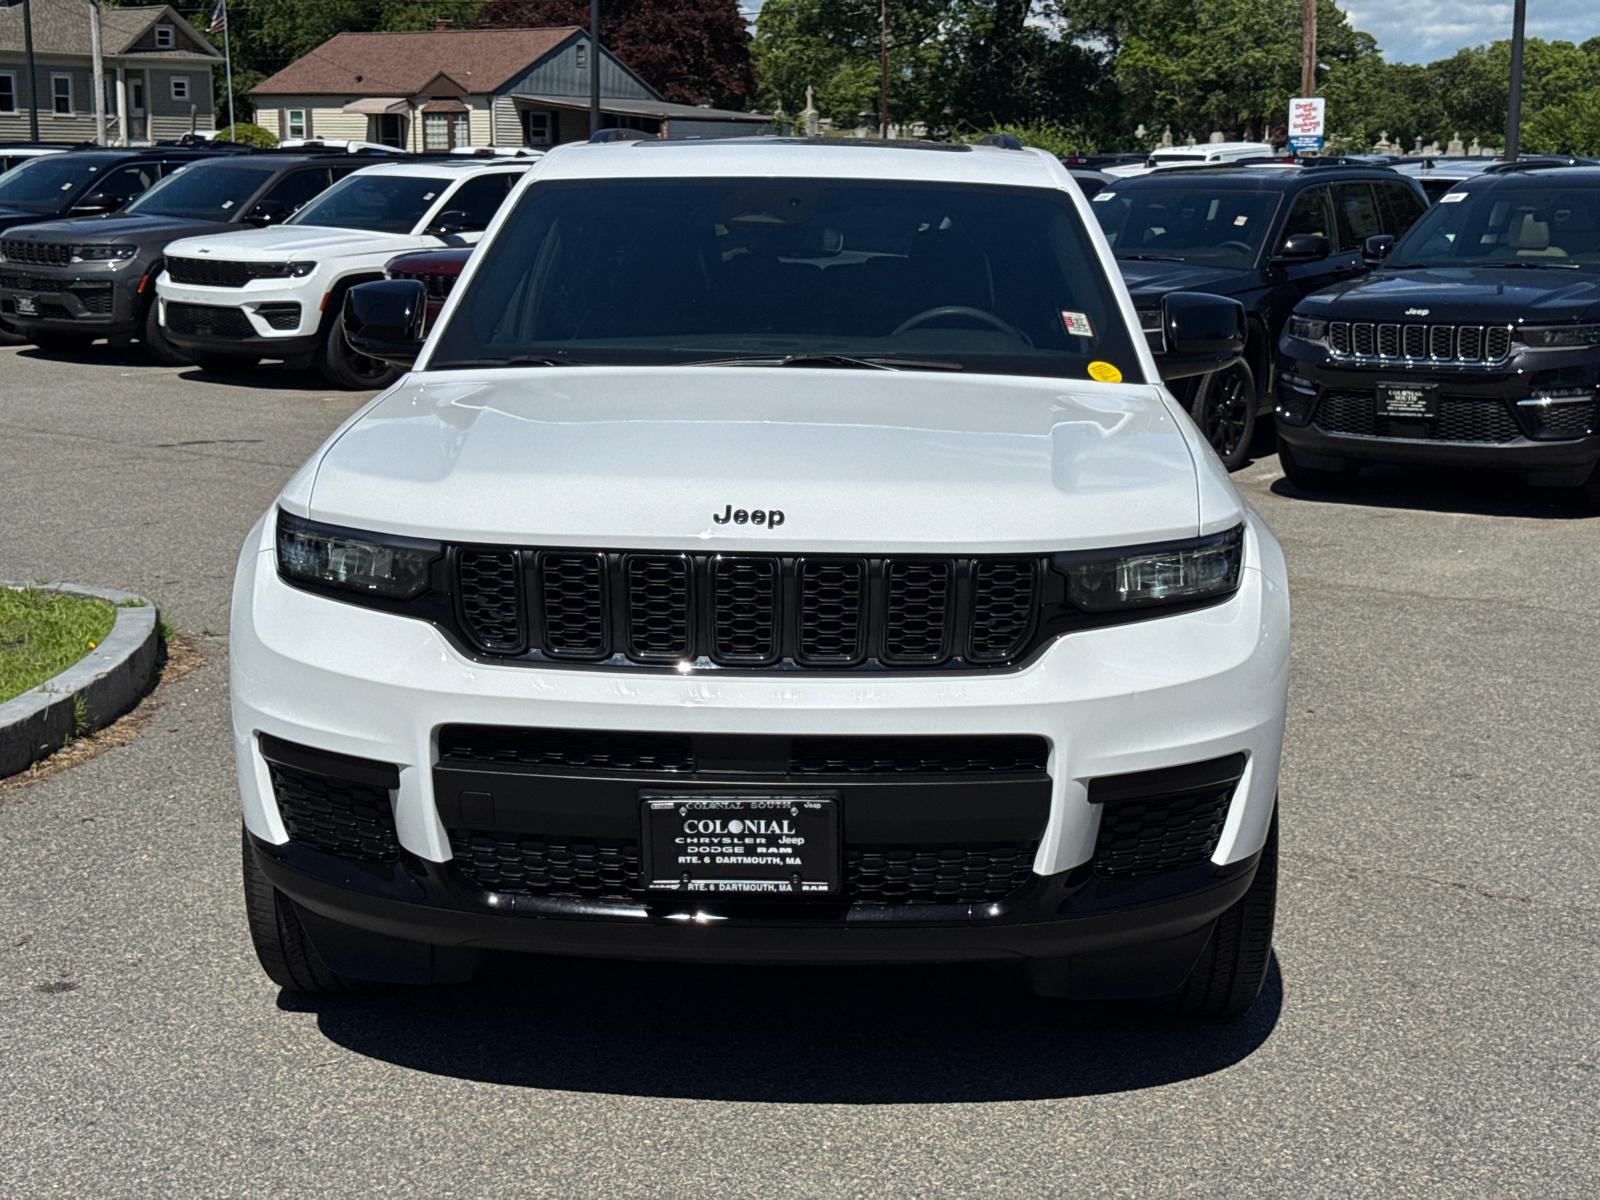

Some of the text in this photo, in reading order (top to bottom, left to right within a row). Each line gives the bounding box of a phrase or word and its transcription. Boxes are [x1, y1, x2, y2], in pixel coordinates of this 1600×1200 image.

[1292, 120, 1321, 129] looking
[1404, 307, 1430, 316] Jeep
[713, 504, 785, 529] Jeep
[686, 801, 792, 810] COLONIAL SOUTH
[683, 819, 796, 834] COLONIAL
[778, 835, 805, 846] Jeep
[678, 856, 802, 866] RTE. 6 DARTMOUTH, MA
[687, 883, 708, 891] RTE.
[709, 883, 715, 891] 6
[719, 883, 777, 892] DARTMOUTH,
